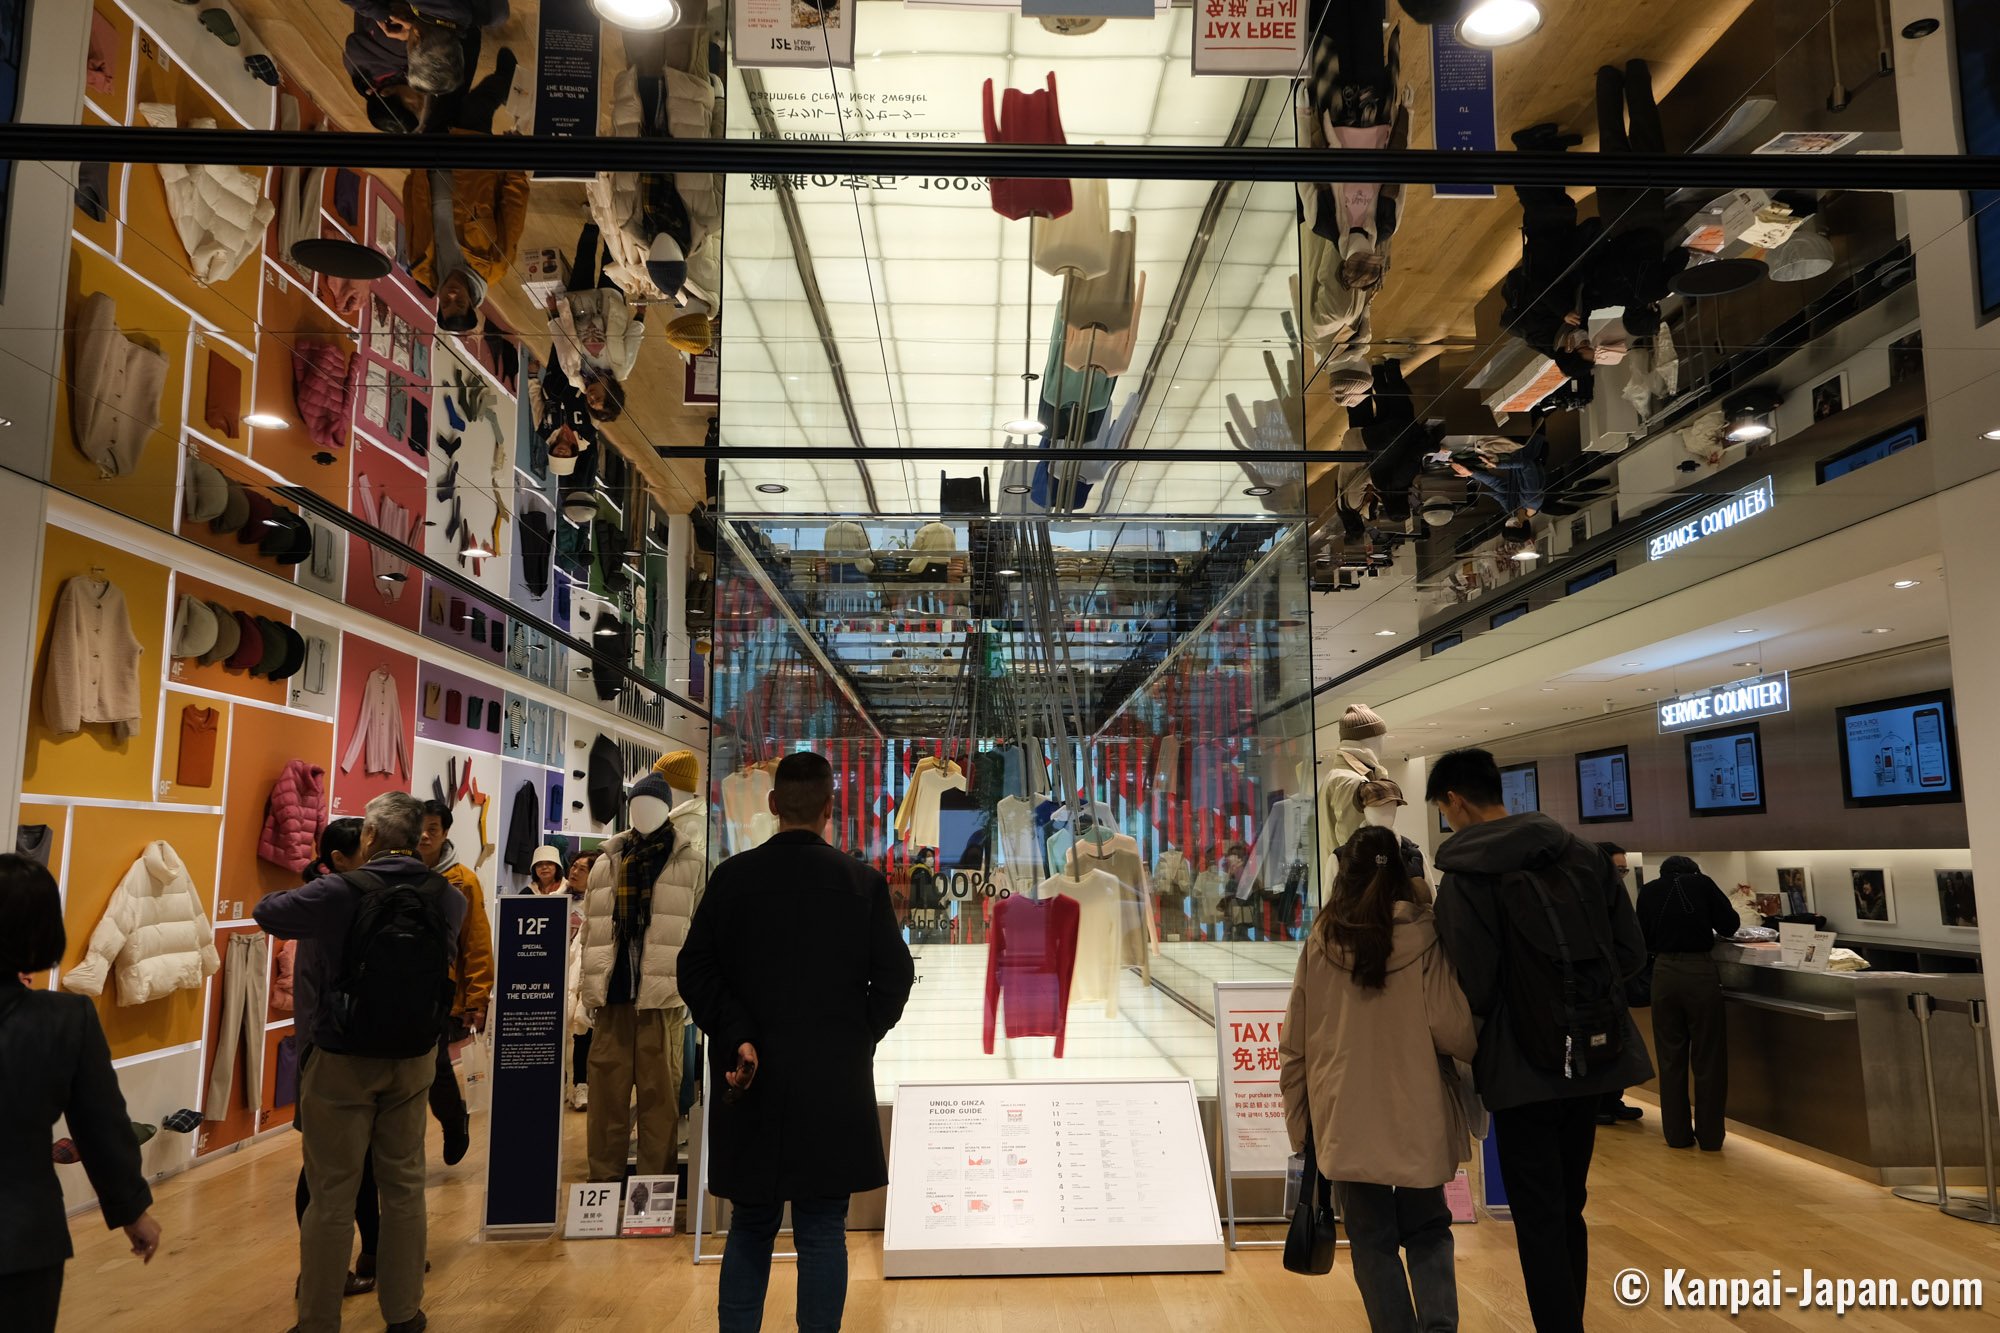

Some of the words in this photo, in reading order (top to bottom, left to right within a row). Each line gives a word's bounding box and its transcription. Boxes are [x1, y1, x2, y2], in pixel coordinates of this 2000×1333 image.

[171, 662, 185, 676] 4F
[291, 690, 301, 702] 9F
[1661, 696, 1713, 726] SERVICE
[1713, 681, 1783, 716] COUNTER
[160, 780, 172, 795] 8F
[334, 797, 342, 808] 4F
[218, 900, 230, 914] 3F
[517, 917, 550, 936] 12F
[506, 992, 520, 1000] THE
[521, 992, 555, 1000] EVERYDAY
[1229, 1022, 1271, 1043] TAX
[1231, 1047, 1281, 1071] 免税
[1248, 1092, 1272, 1100] purchase
[929, 1100, 959, 1108] UNIQLO
[961, 1099, 986, 1107] GINZA
[958, 1107, 983, 1115] GUIDE
[579, 1189, 611, 1207] 12F
